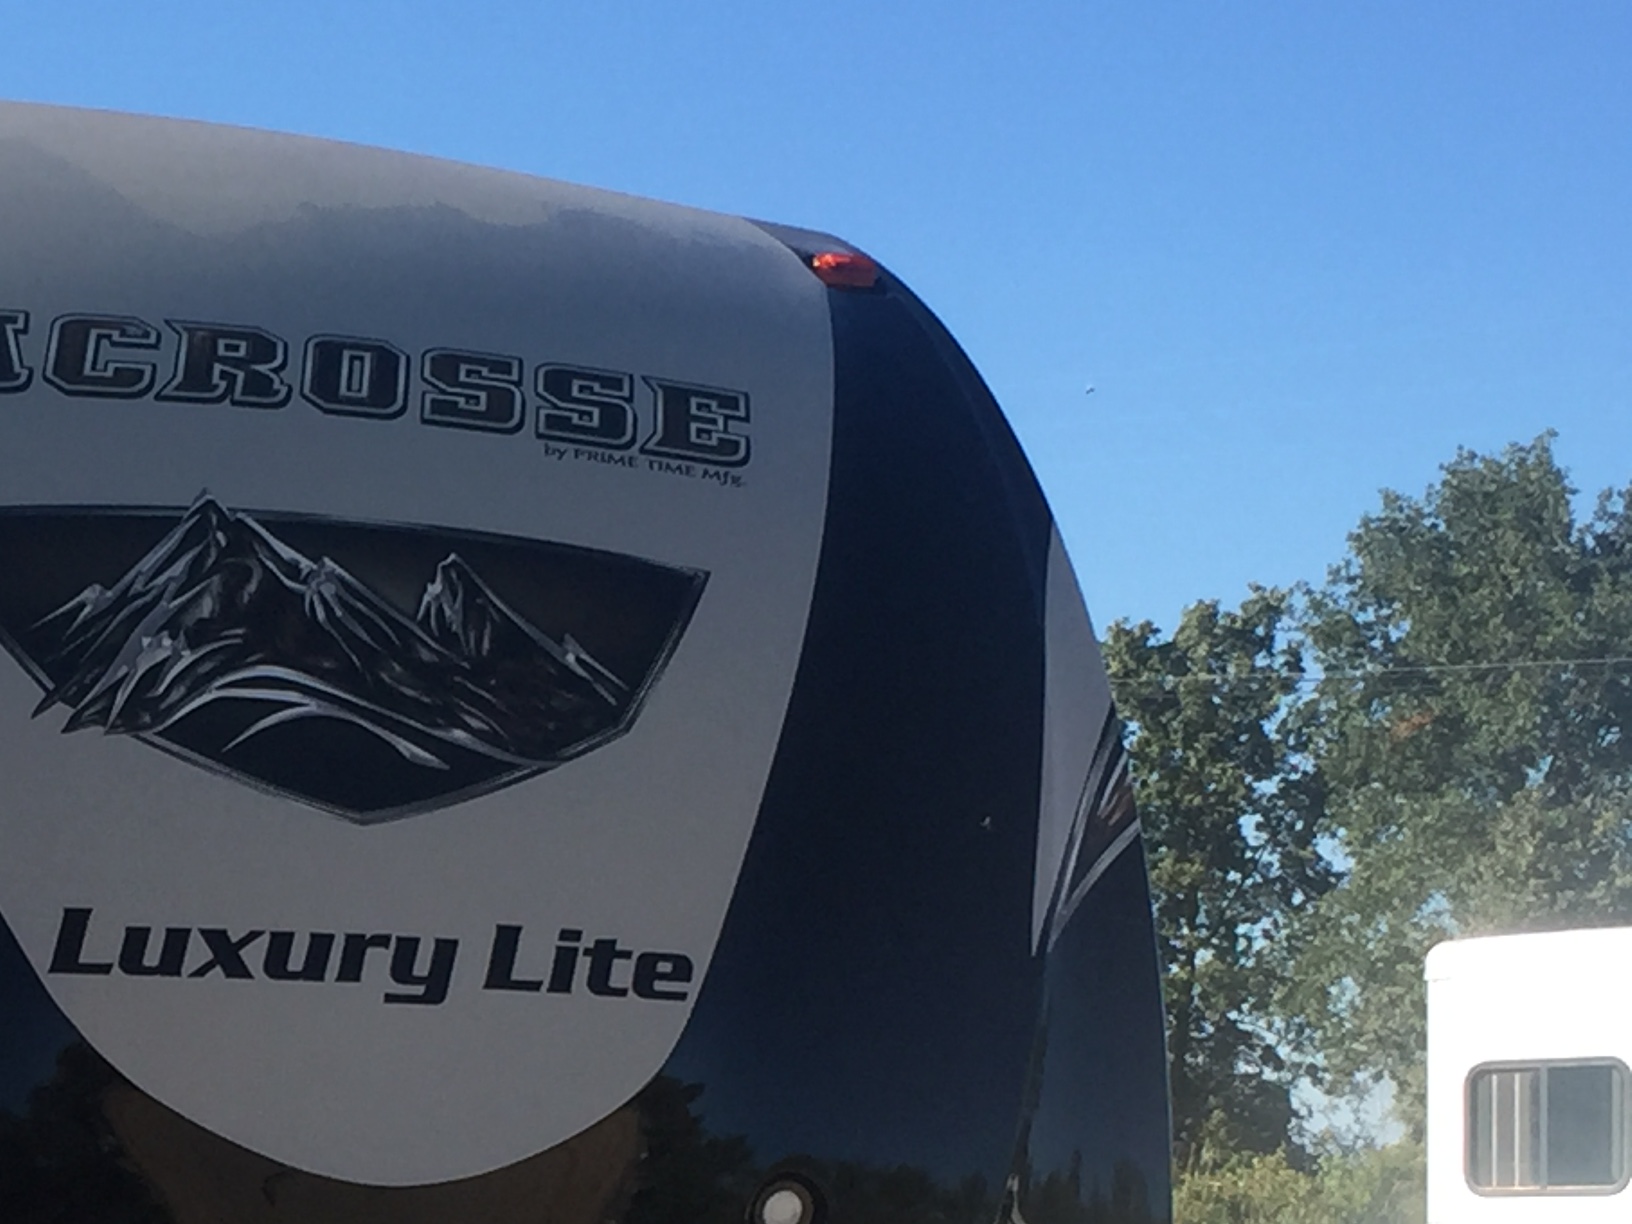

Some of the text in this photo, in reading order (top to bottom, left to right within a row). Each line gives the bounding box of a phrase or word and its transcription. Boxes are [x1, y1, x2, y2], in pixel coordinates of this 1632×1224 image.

[543, 442, 568, 462] by
[573, 447, 639, 469] PRIME
[646, 457, 696, 478] TIME
[48, 907, 695, 1006] Luxury Lite
